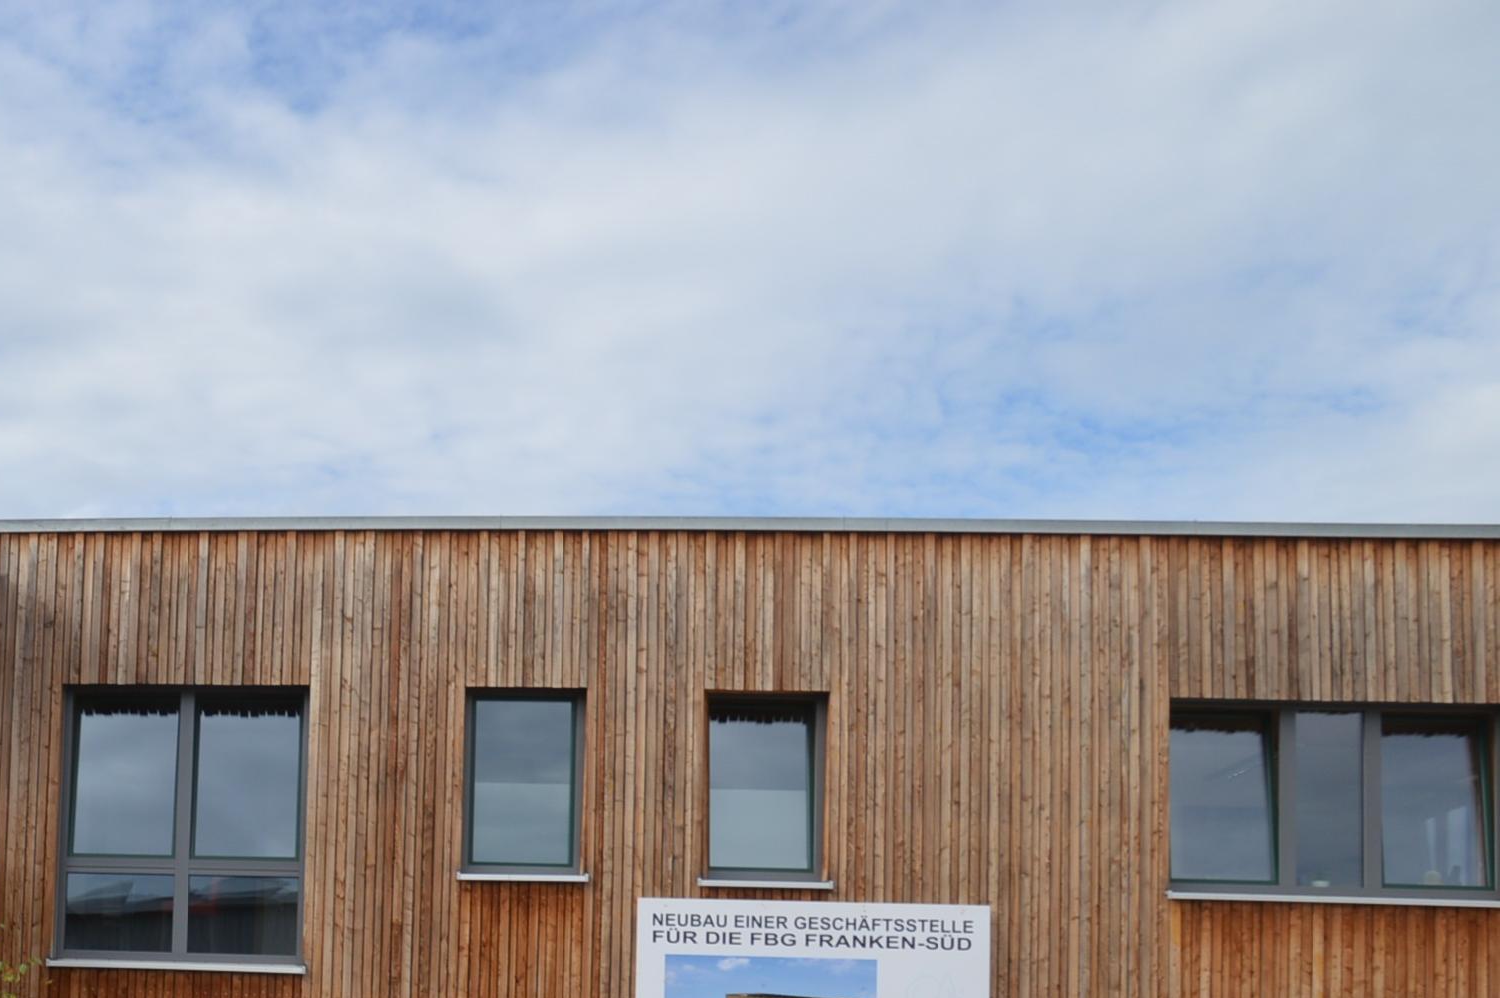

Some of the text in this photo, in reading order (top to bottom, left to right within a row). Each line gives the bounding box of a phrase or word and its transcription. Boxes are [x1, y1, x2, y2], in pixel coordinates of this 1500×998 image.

[652, 913, 974, 934] NEUBAU EINER GESCHÄFTSSTELLE
[652, 928, 972, 951] FÜR DIE FBG FRANKEN-SÜD
